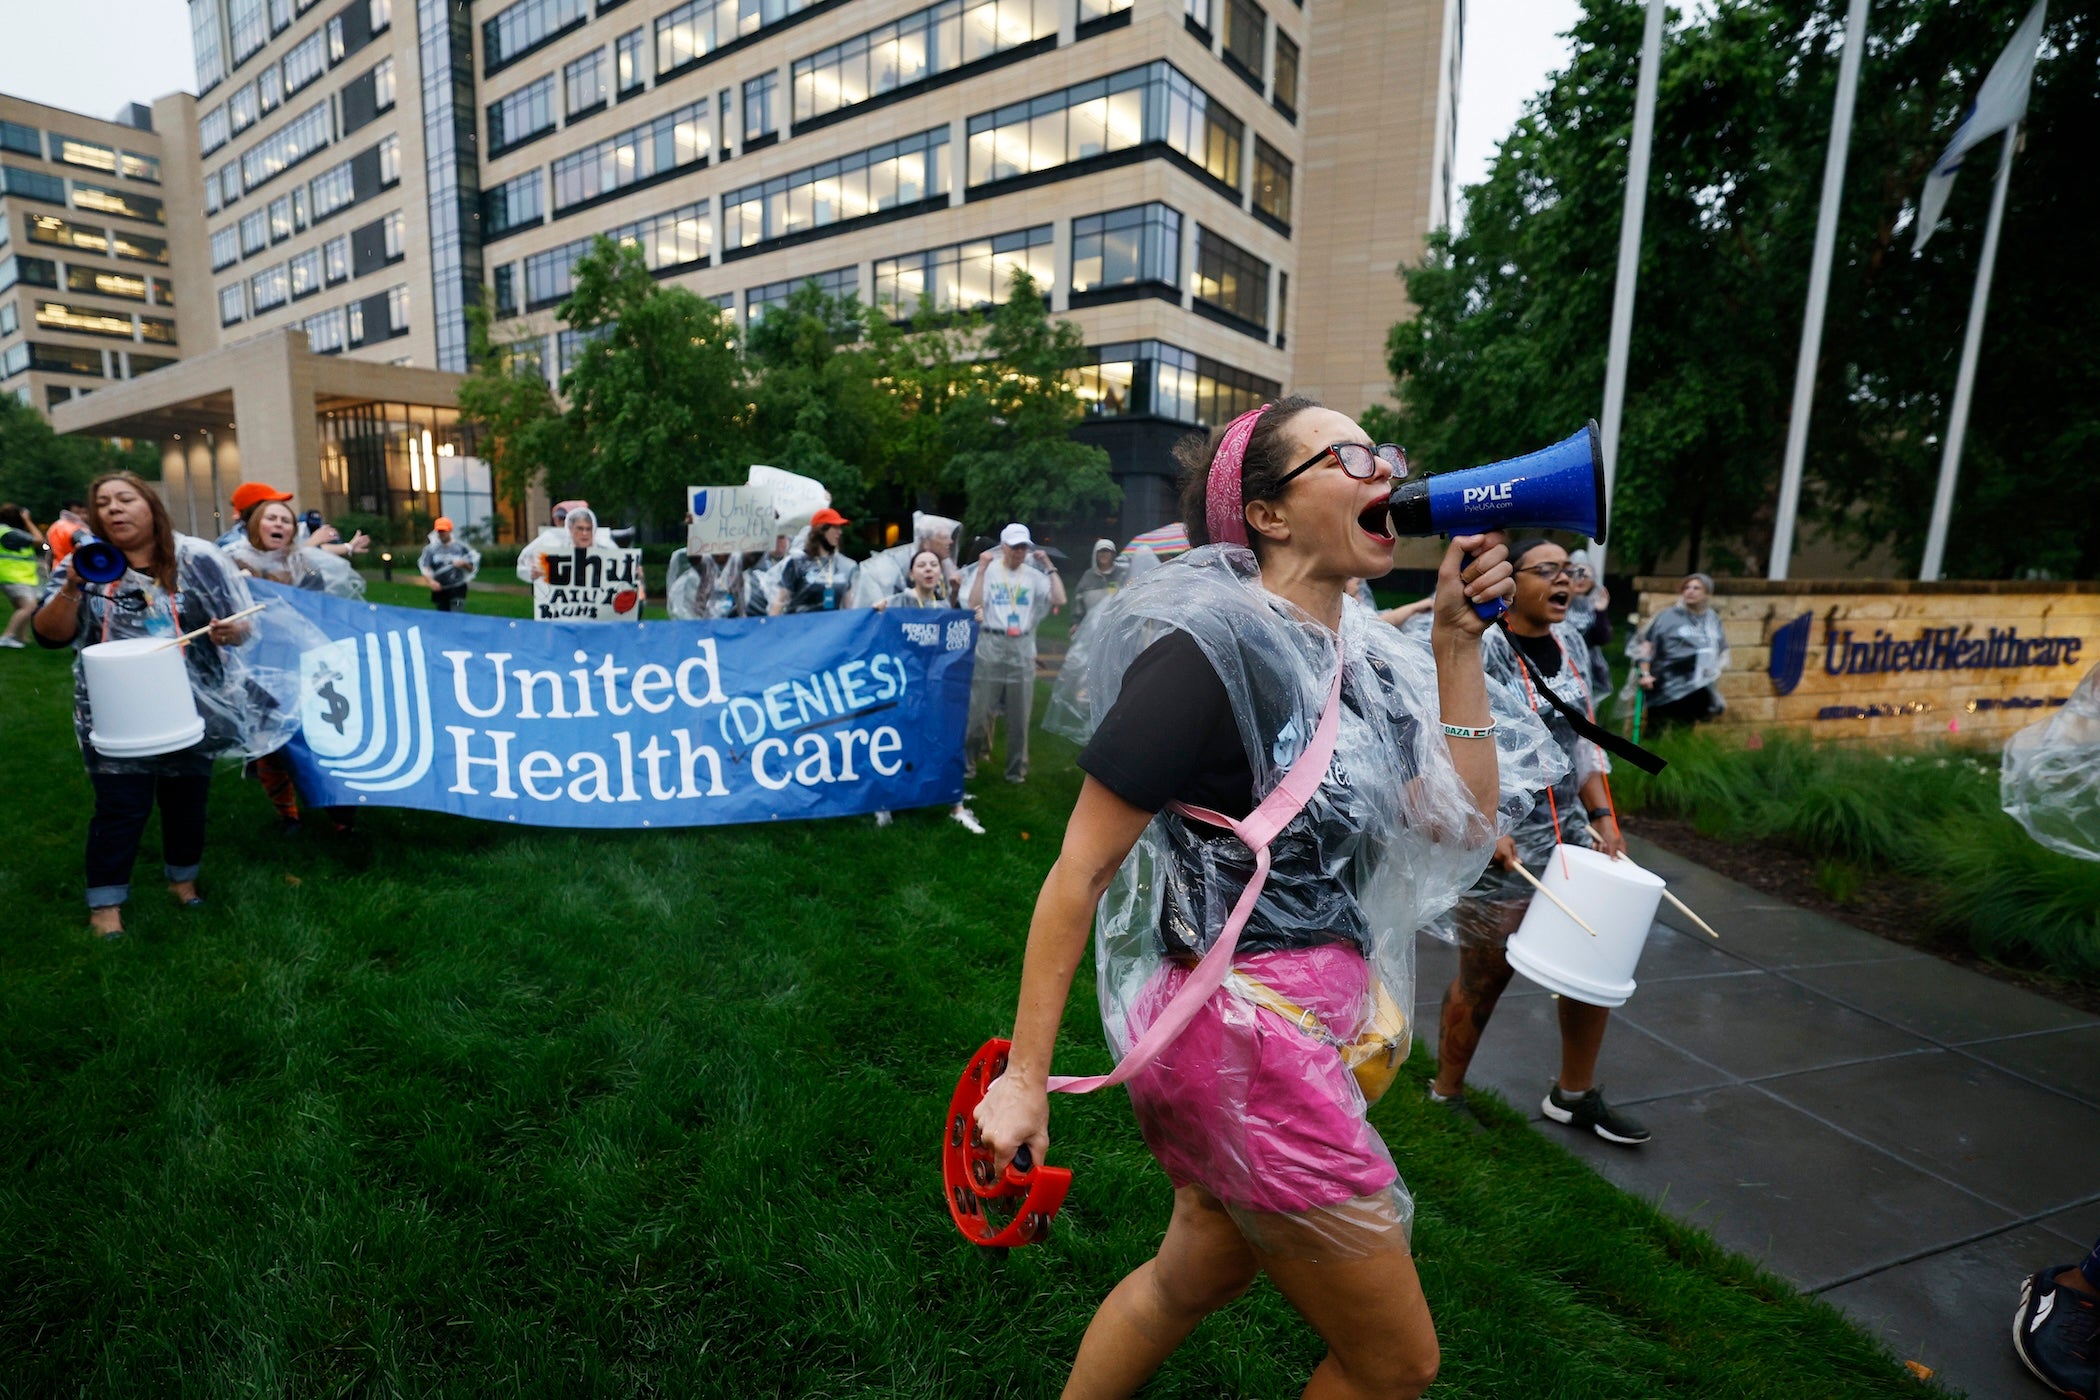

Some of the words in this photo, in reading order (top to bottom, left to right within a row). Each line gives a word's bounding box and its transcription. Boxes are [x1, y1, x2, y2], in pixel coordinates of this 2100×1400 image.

[719, 488, 774, 519] United
[1463, 482, 1512, 504] PYLE
[717, 517, 770, 538] Health
[1825, 625, 2083, 677] UnitedHealthcare
[442, 637, 729, 719] United
[719, 653, 907, 745] (DENIES)
[1445, 726, 1470, 736] GAZA
[444, 727, 731, 803] Health
